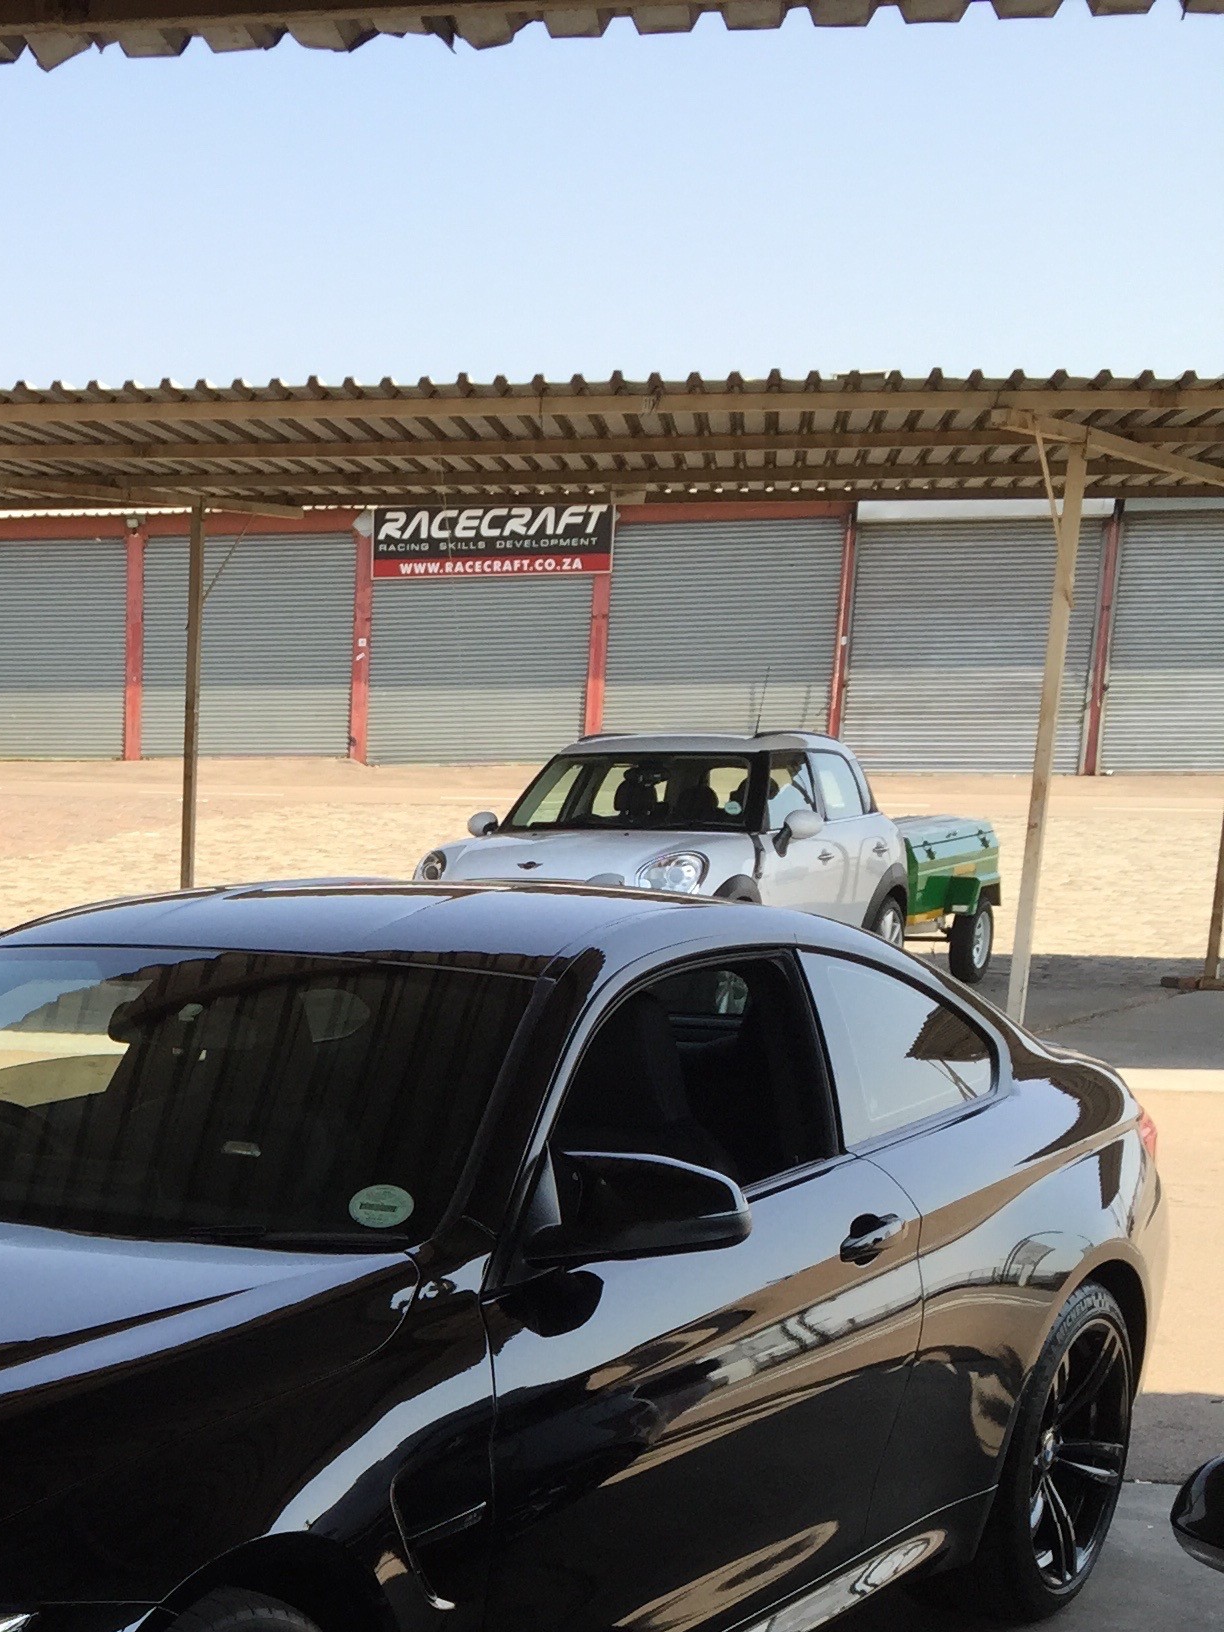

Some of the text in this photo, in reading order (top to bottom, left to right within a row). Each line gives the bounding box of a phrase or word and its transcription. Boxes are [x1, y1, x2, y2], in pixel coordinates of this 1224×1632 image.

[378, 505, 608, 540] RACECRAFT
[379, 537, 598, 552] RACING SKILLS DEVELOPMENT
[399, 558, 583, 574] WWW.RACECRAFT.CO.ZA
